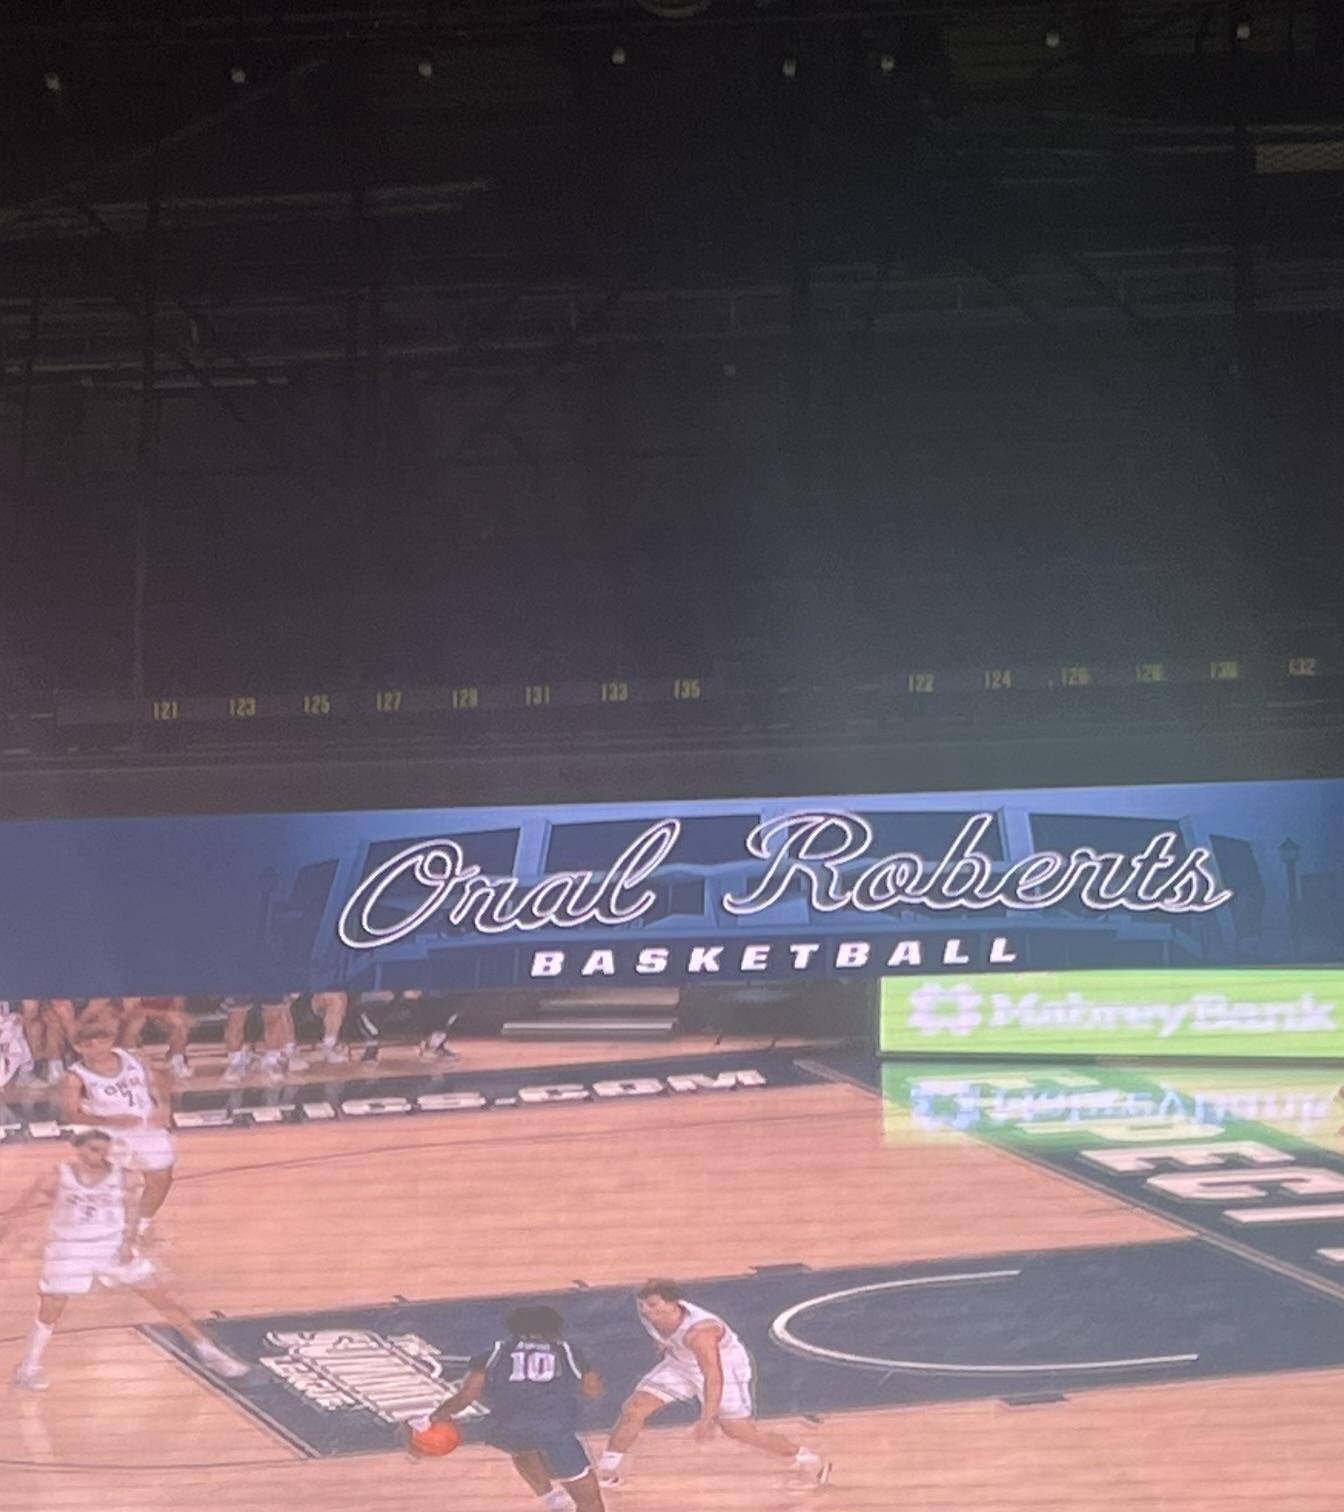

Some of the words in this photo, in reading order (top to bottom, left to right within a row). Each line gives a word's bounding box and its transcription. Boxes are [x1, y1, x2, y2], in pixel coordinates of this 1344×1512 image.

[337, 818, 681, 950] Oral
[724, 809, 1232, 917] Roberts
[531, 938, 1021, 978] BASKETBALL
[509, 1352, 555, 1382] 10
